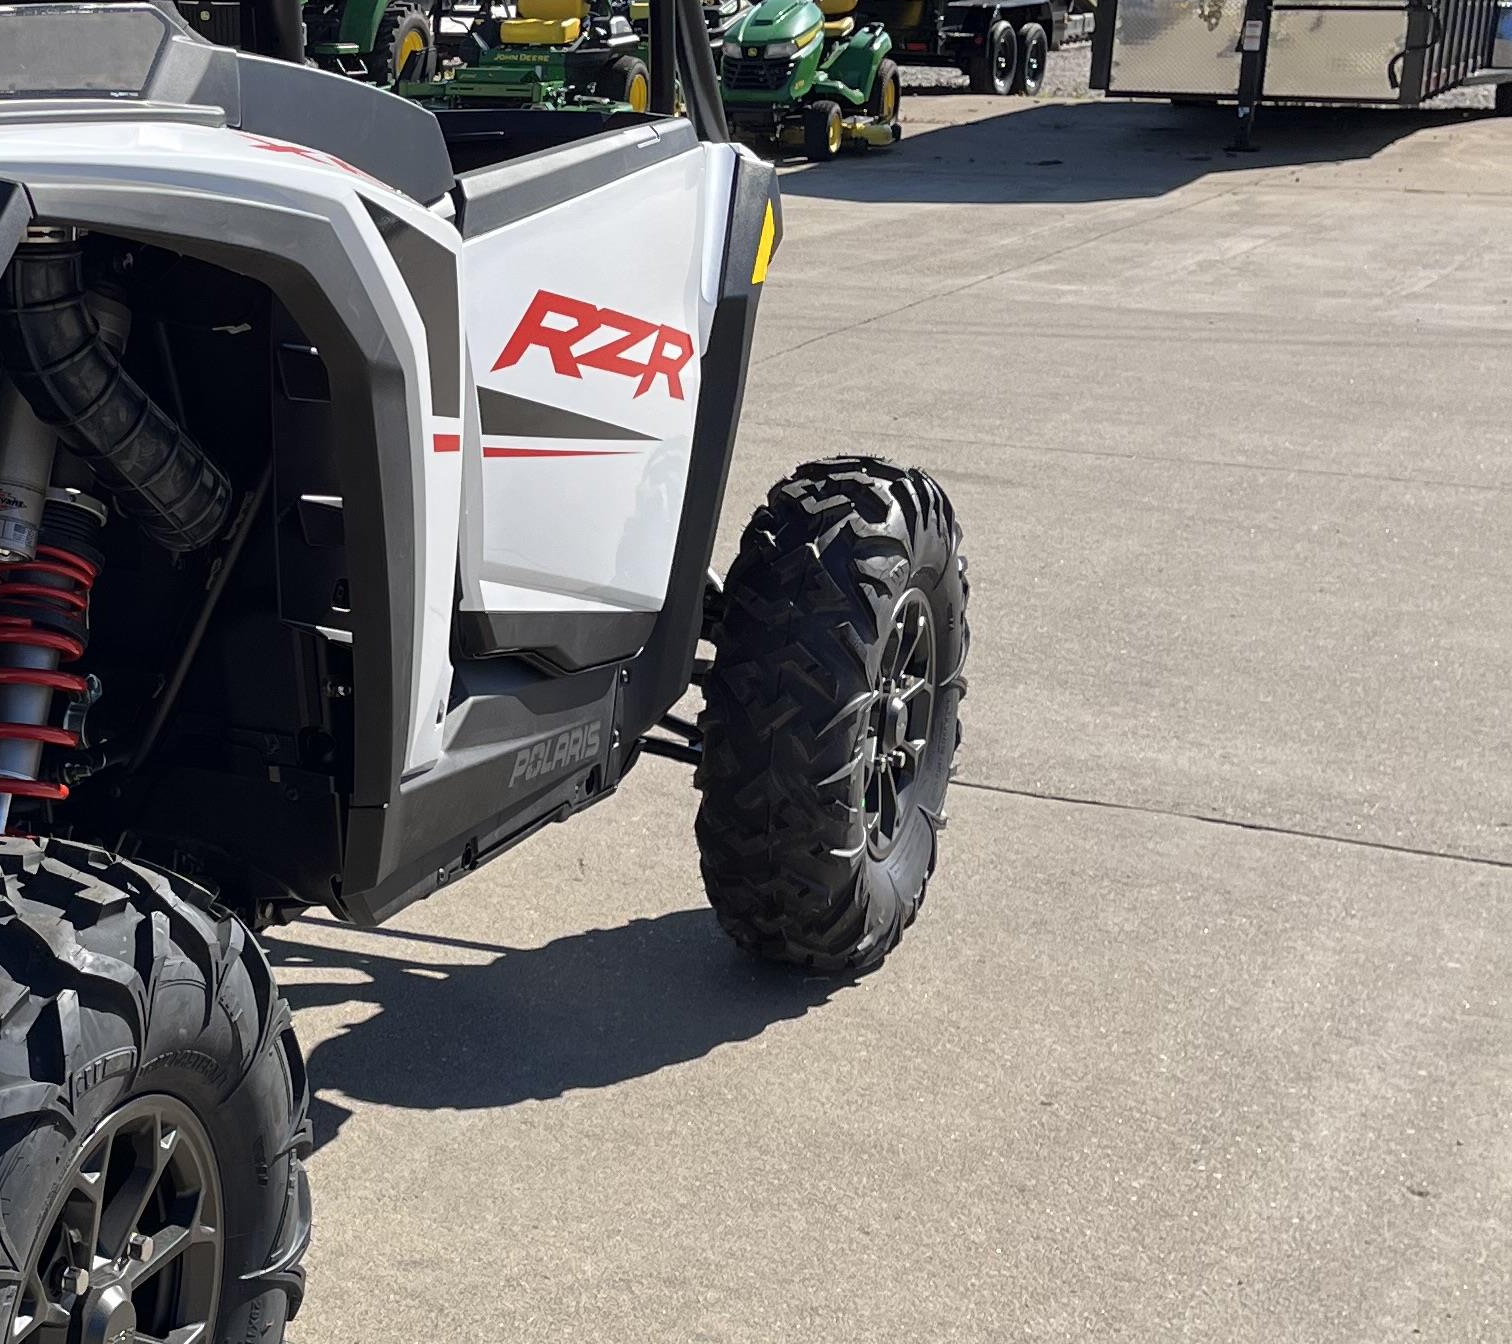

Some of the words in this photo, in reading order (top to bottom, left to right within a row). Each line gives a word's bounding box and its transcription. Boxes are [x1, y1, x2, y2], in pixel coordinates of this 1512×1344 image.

[519, 53, 551, 62] DEERE
[490, 289, 694, 401] RZR
[508, 720, 601, 788] POLARIS
